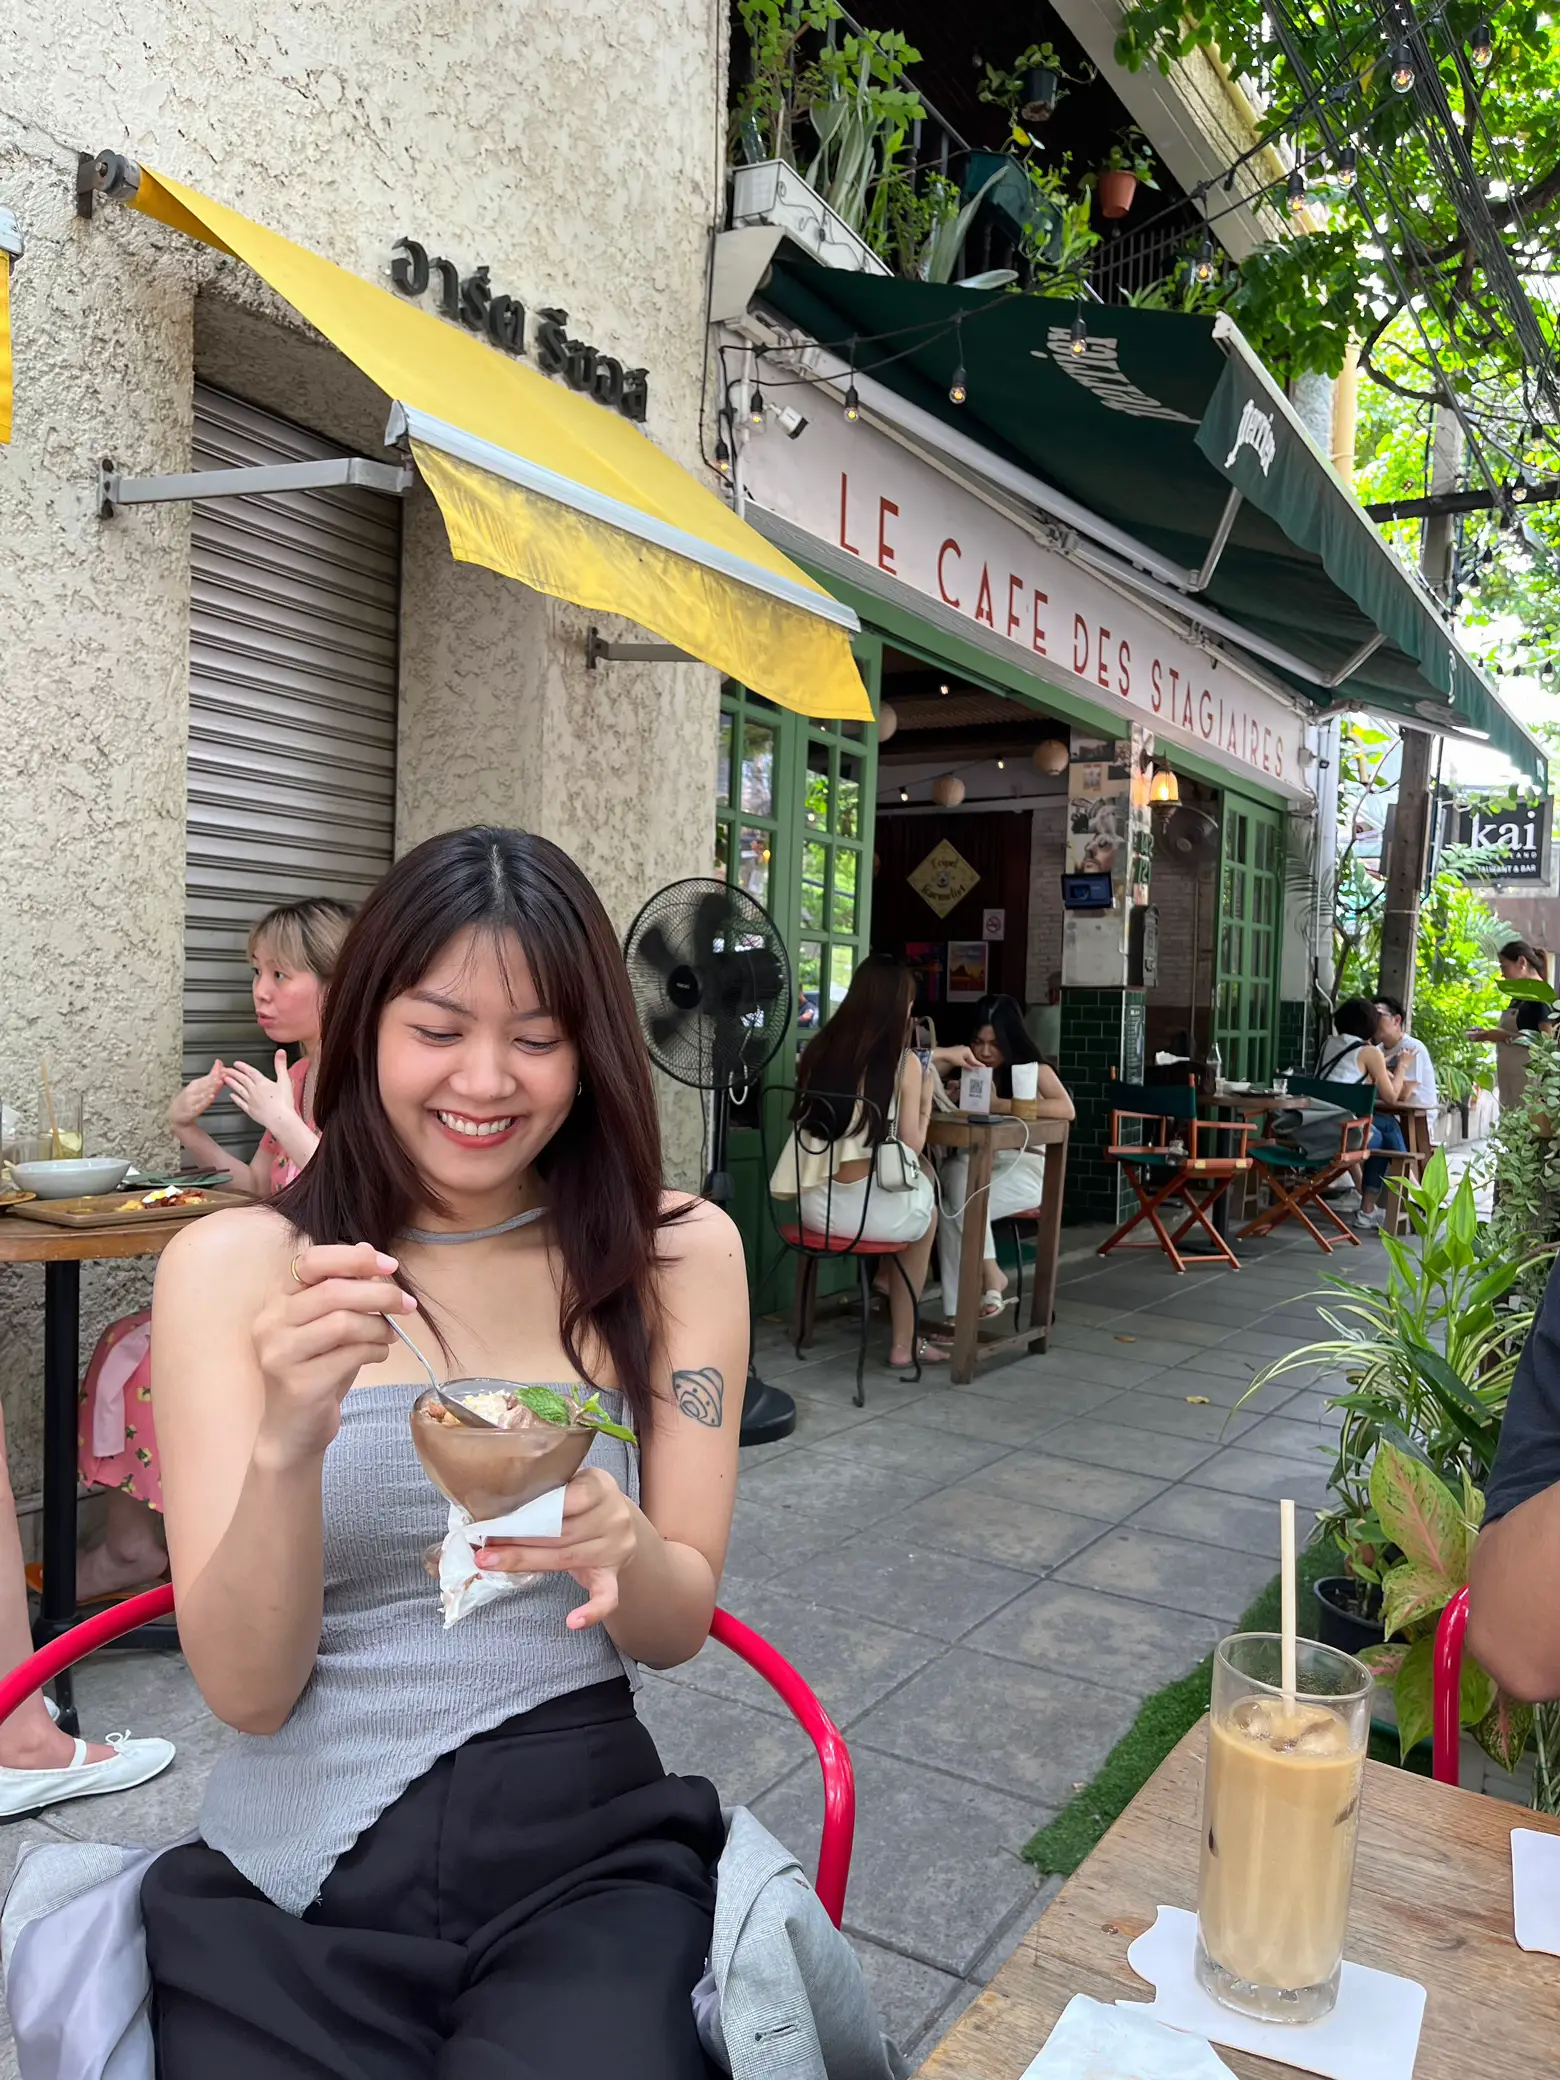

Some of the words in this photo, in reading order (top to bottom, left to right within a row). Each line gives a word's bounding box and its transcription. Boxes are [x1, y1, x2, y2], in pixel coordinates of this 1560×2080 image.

[840, 471, 900, 576] LE
[937, 538, 1049, 656] CAFE
[1073, 613, 1132, 697] DES
[1151, 659, 1285, 778] STAGIAIRES
[1470, 810, 1538, 851] kai
[1520, 864, 1537, 873] BAR
